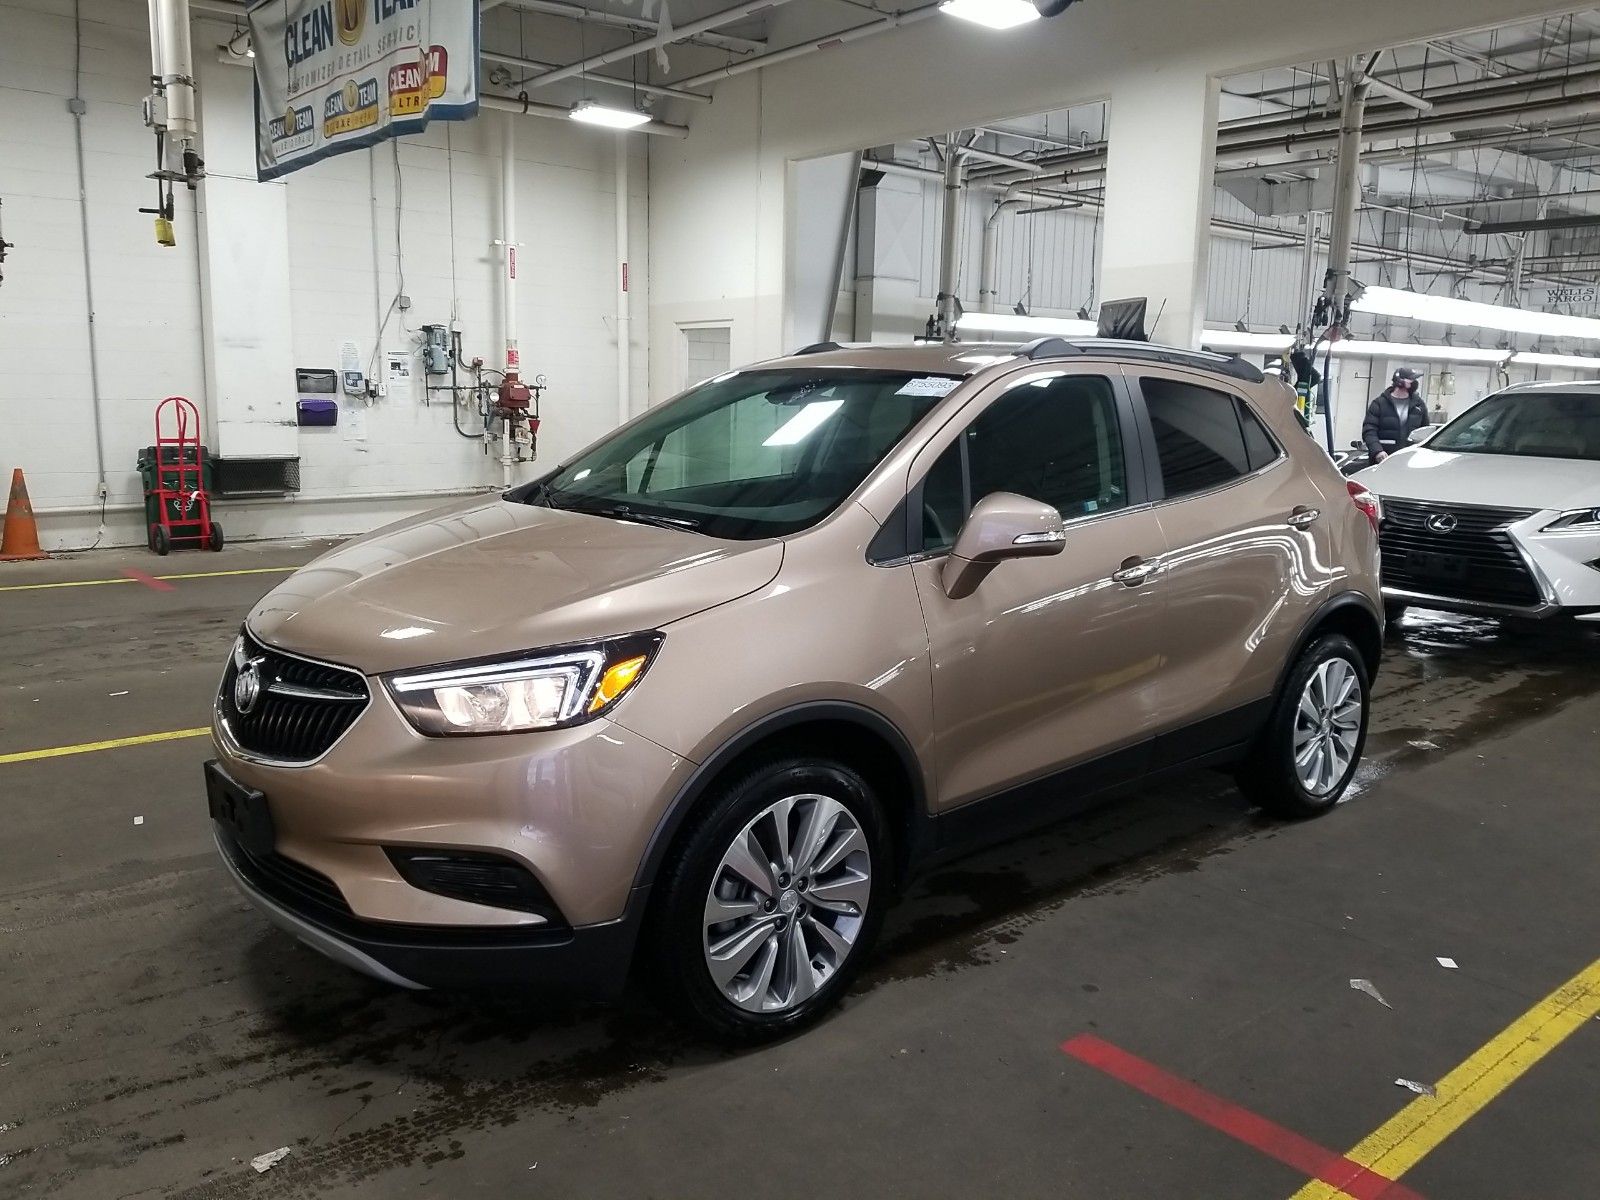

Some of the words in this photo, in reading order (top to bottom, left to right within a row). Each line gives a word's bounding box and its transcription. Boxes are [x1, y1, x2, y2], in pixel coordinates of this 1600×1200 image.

[285, 0, 334, 68] CLEAN
[359, 82, 377, 107] TEAM
[296, 108, 313, 131] TEAM
[1547, 288, 1594, 296] WELLS
[1547, 295, 1592, 303] FARGO
